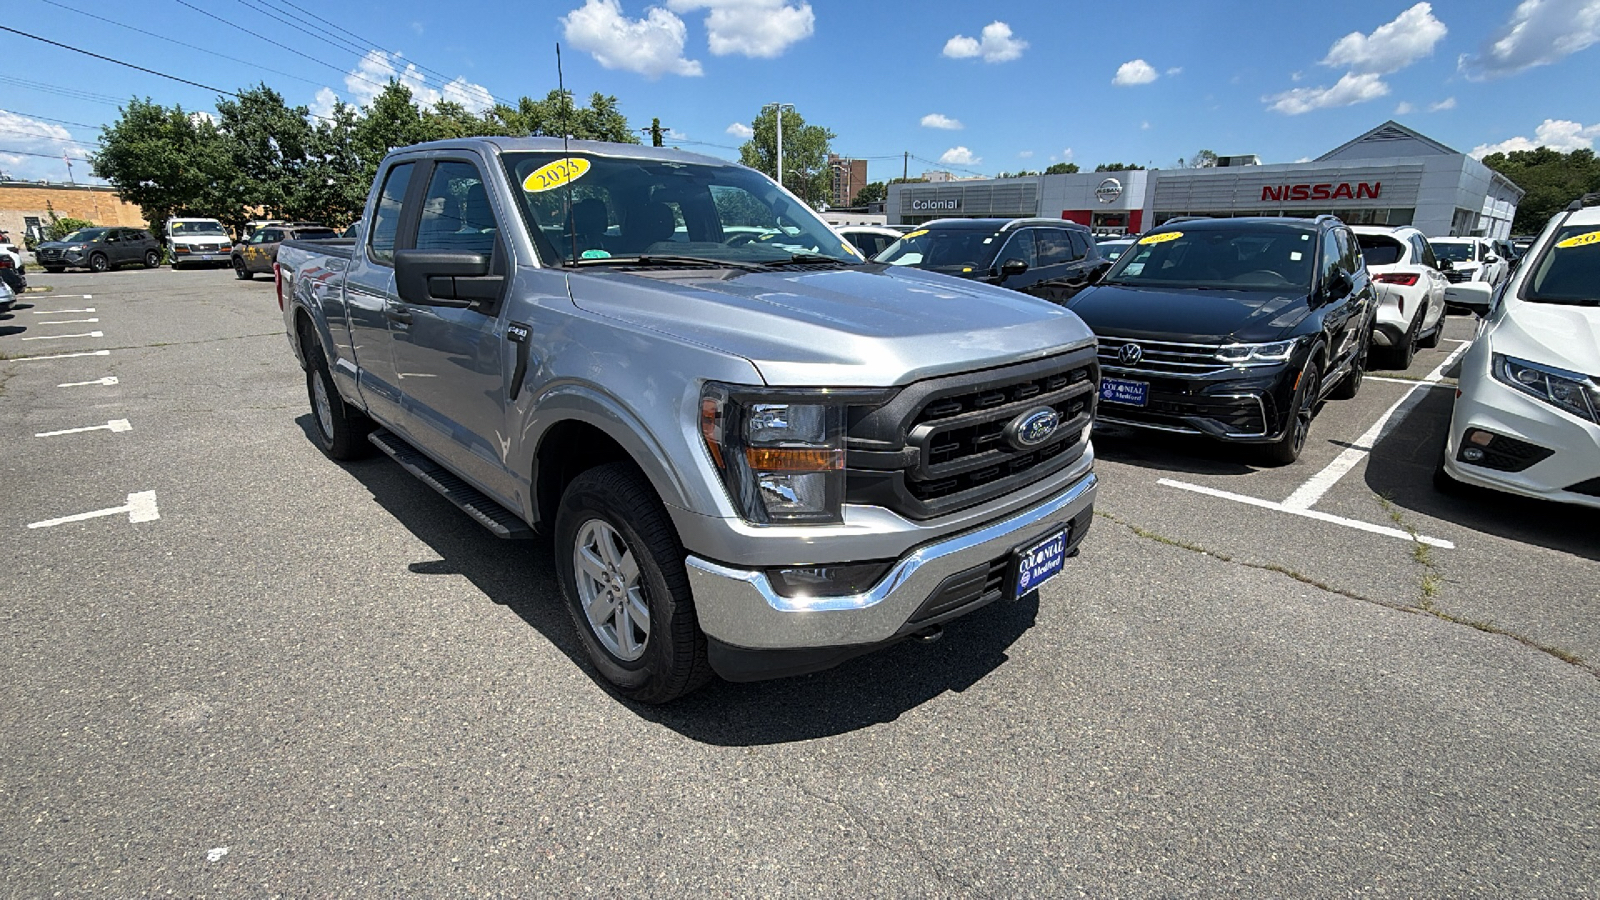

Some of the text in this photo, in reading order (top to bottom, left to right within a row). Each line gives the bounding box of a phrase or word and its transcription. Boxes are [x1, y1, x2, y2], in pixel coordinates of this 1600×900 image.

[536, 161, 579, 187] 2023
[1261, 182, 1381, 200] NISSAN
[912, 199, 958, 210] Colonial
[1102, 383, 1143, 395] COLONIAL
[1115, 392, 1142, 401] Medford
[1020, 541, 1064, 573] COLONIAL
[1033, 555, 1061, 579] Medford
